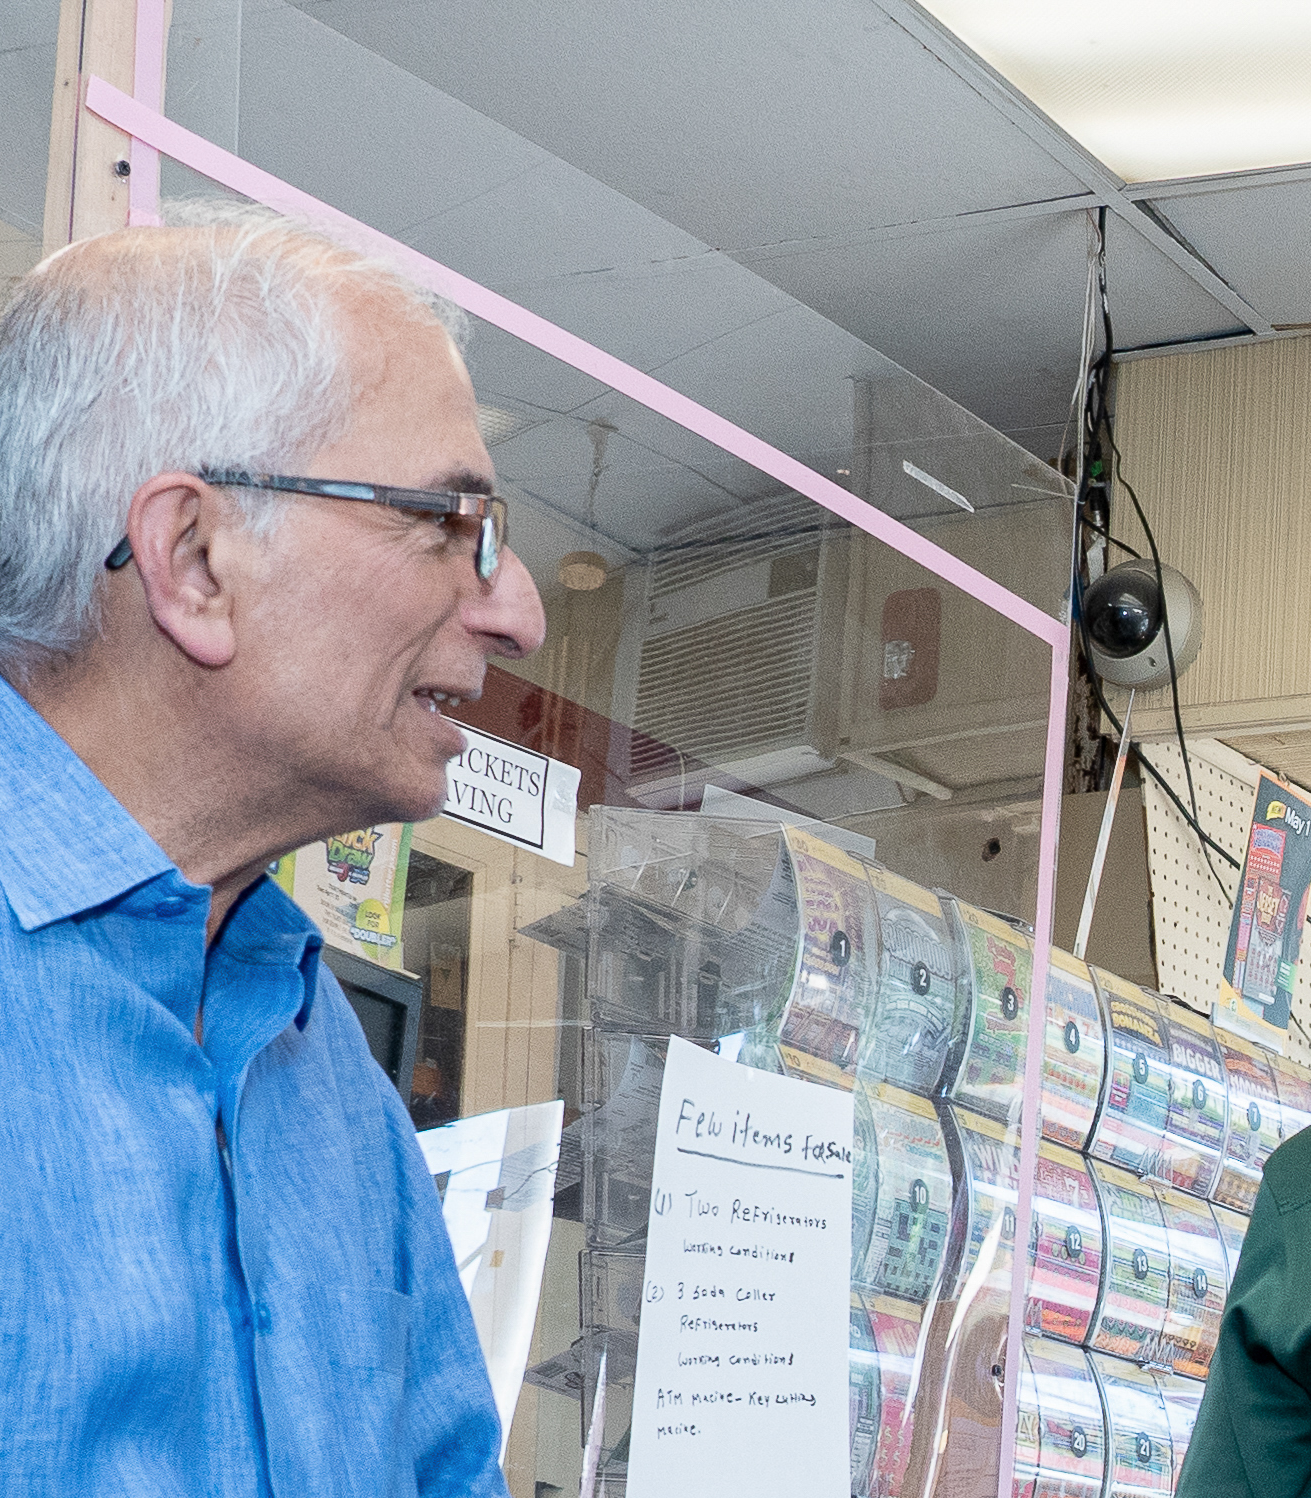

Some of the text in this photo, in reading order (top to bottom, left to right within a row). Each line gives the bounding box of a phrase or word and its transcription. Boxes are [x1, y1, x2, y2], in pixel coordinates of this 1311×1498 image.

[448, 747, 540, 797] ICKETS
[446, 779, 513, 824] VING
[1284, 806, 1311, 836] May 1
[839, 939, 846, 959] 1
[919, 969, 928, 987] 2
[1006, 994, 1015, 1012] 3
[1069, 1027, 1076, 1045] 4
[1139, 1059, 1147, 1076] 5
[1172, 1043, 1222, 1080] BIGGER
[1197, 1086, 1204, 1102] 6
[676, 1098, 722, 1138] Few
[731, 1110, 793, 1154] items
[685, 1190, 719, 1218] Two
[914, 1186, 927, 1205] 10
[1004, 1214, 1015, 1232] 11
[1069, 1232, 1081, 1250] 12
[1137, 1260, 1148, 1274] 13
[646, 1280, 665, 1303] (2)
[676, 1281, 685, 1300] 3
[1197, 1279, 1208, 1291] 14
[656, 1388, 683, 1409] ATM
[748, 1391, 770, 1407] Key
[1074, 1432, 1086, 1451] 20
[1140, 1440, 1151, 1456] 21
